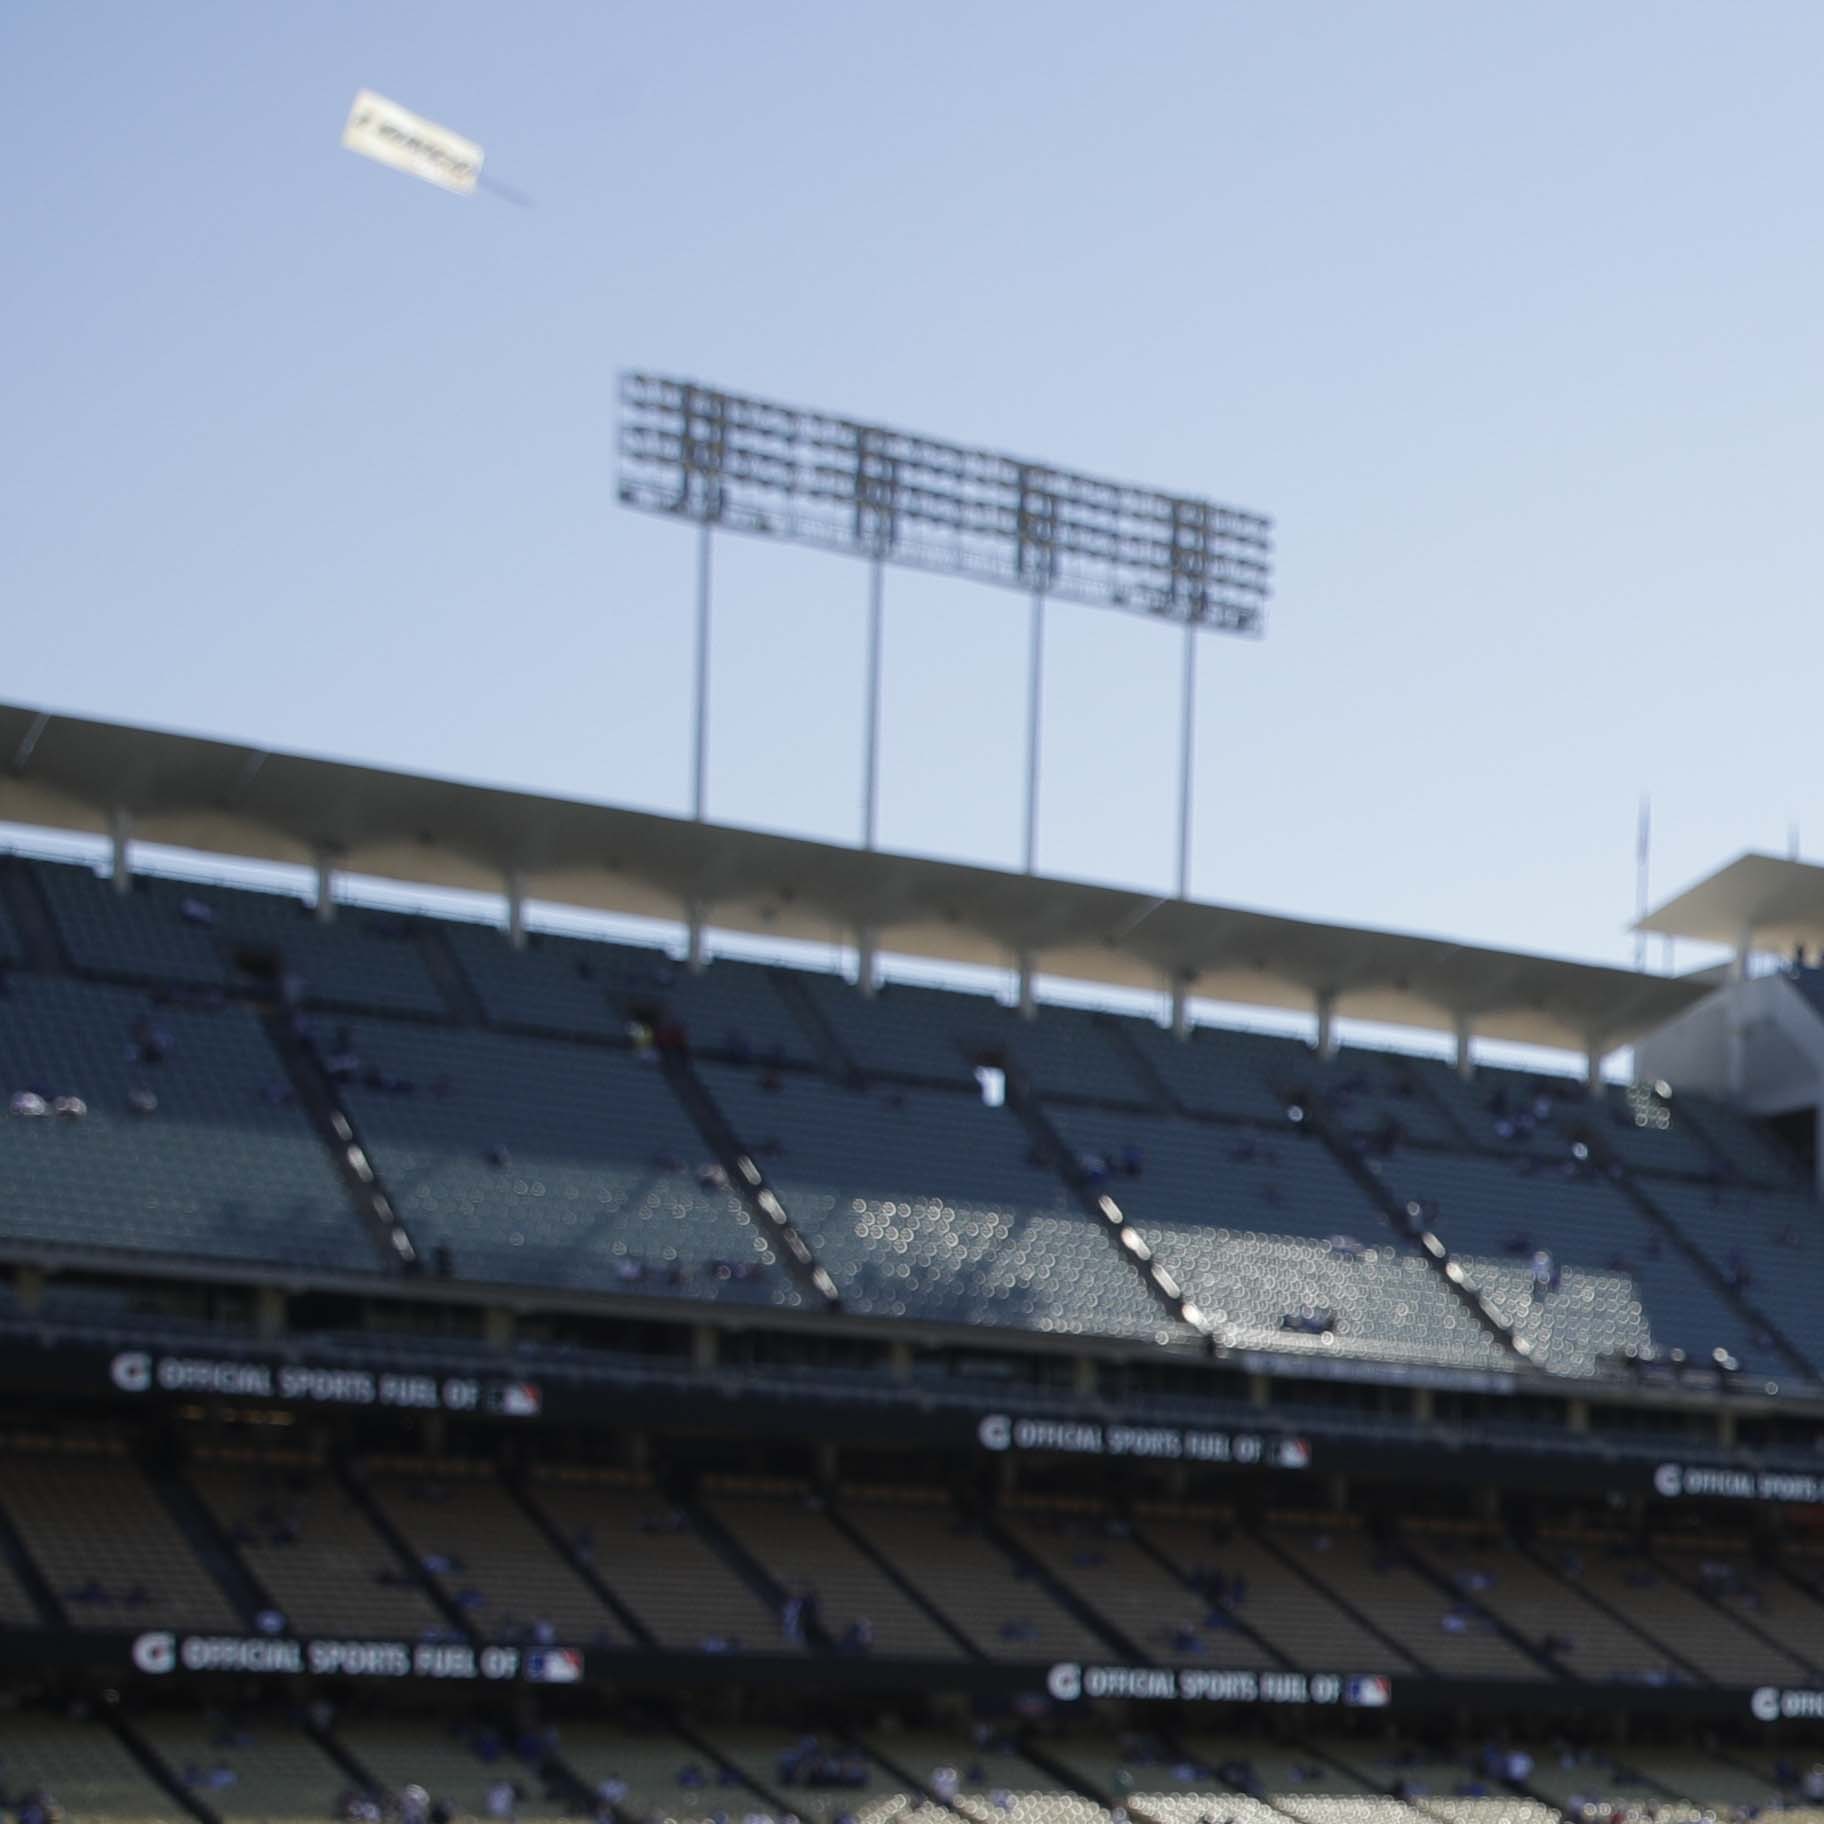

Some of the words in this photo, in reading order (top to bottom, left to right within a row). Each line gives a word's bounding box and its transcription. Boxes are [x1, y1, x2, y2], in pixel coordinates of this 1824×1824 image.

[157, 1357, 271, 1397] OFFICIAL
[277, 1365, 376, 1403] SPORTS
[379, 1373, 438, 1408] FUEL
[443, 1378, 479, 1410] OF
[181, 1636, 302, 1673] OFFICIAL
[307, 1639, 410, 1676] SPORTS
[413, 1644, 477, 1678] FUEL
[480, 1646, 517, 1679] OF
[1084, 1667, 1176, 1698] OFFICIAL
[1179, 1669, 1258, 1701] SPORTS
[1260, 1671, 1309, 1703] FUEL
[1310, 1673, 1341, 1703] OF
